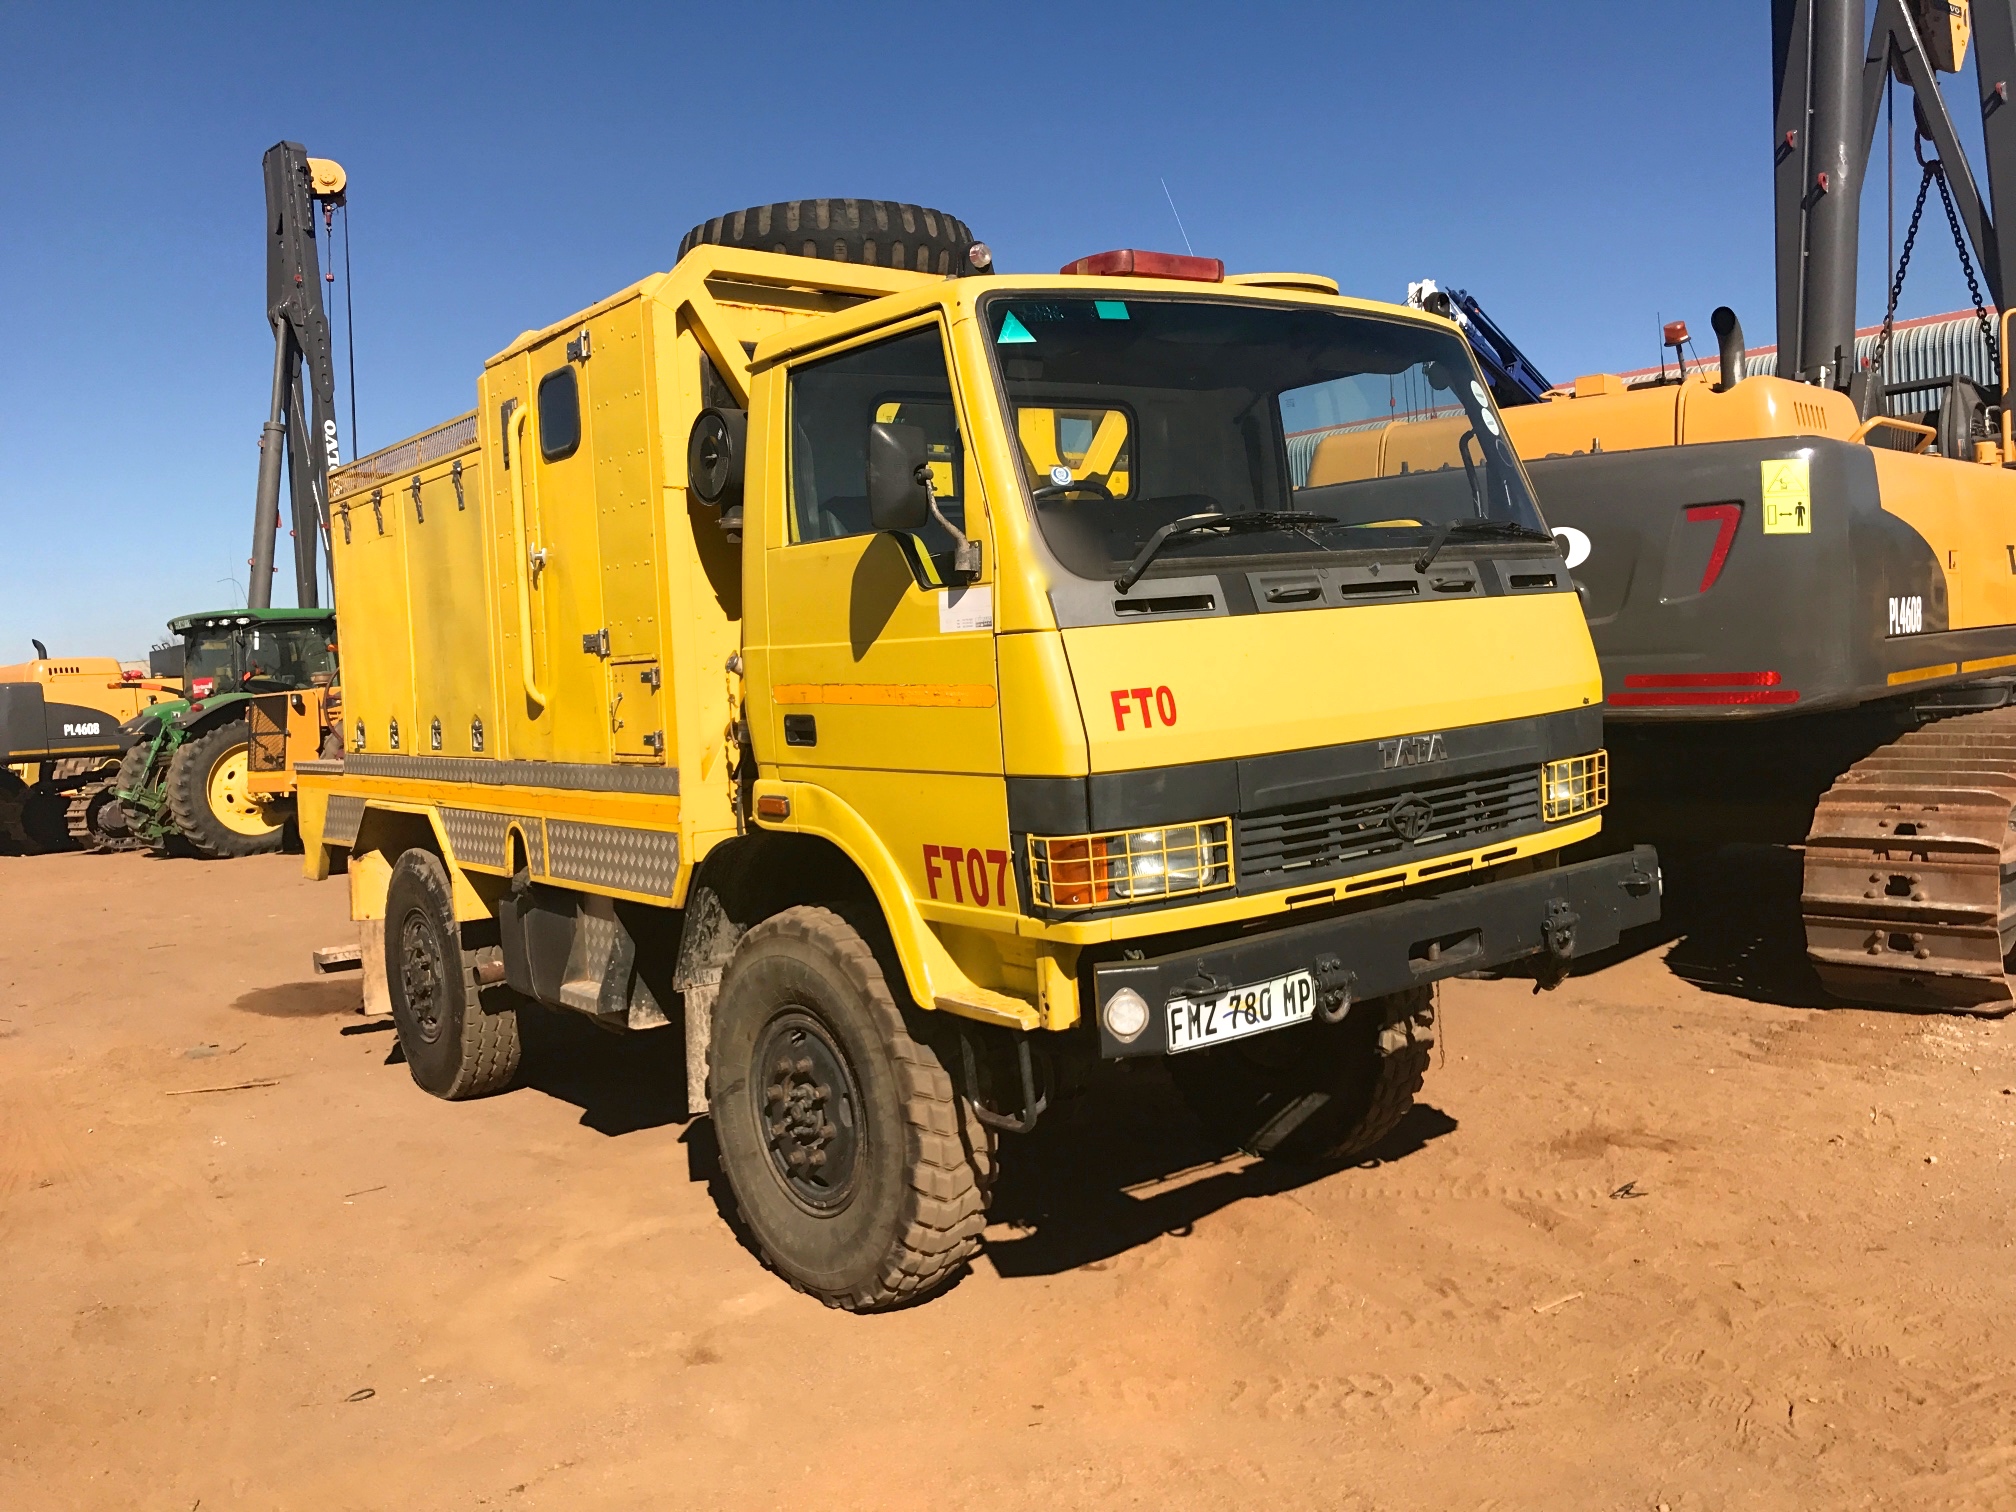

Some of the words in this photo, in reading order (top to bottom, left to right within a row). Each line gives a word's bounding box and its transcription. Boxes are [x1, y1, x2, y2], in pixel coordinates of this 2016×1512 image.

[1889, 596, 1922, 635] PL4608
[63, 722, 100, 736] PL4608
[1379, 734, 1448, 769] TATA
[922, 844, 1008, 907] FT07
[1171, 1000, 1218, 1045] FMZ
[1229, 988, 1272, 1029] 780
[1283, 978, 1311, 1017] MP
